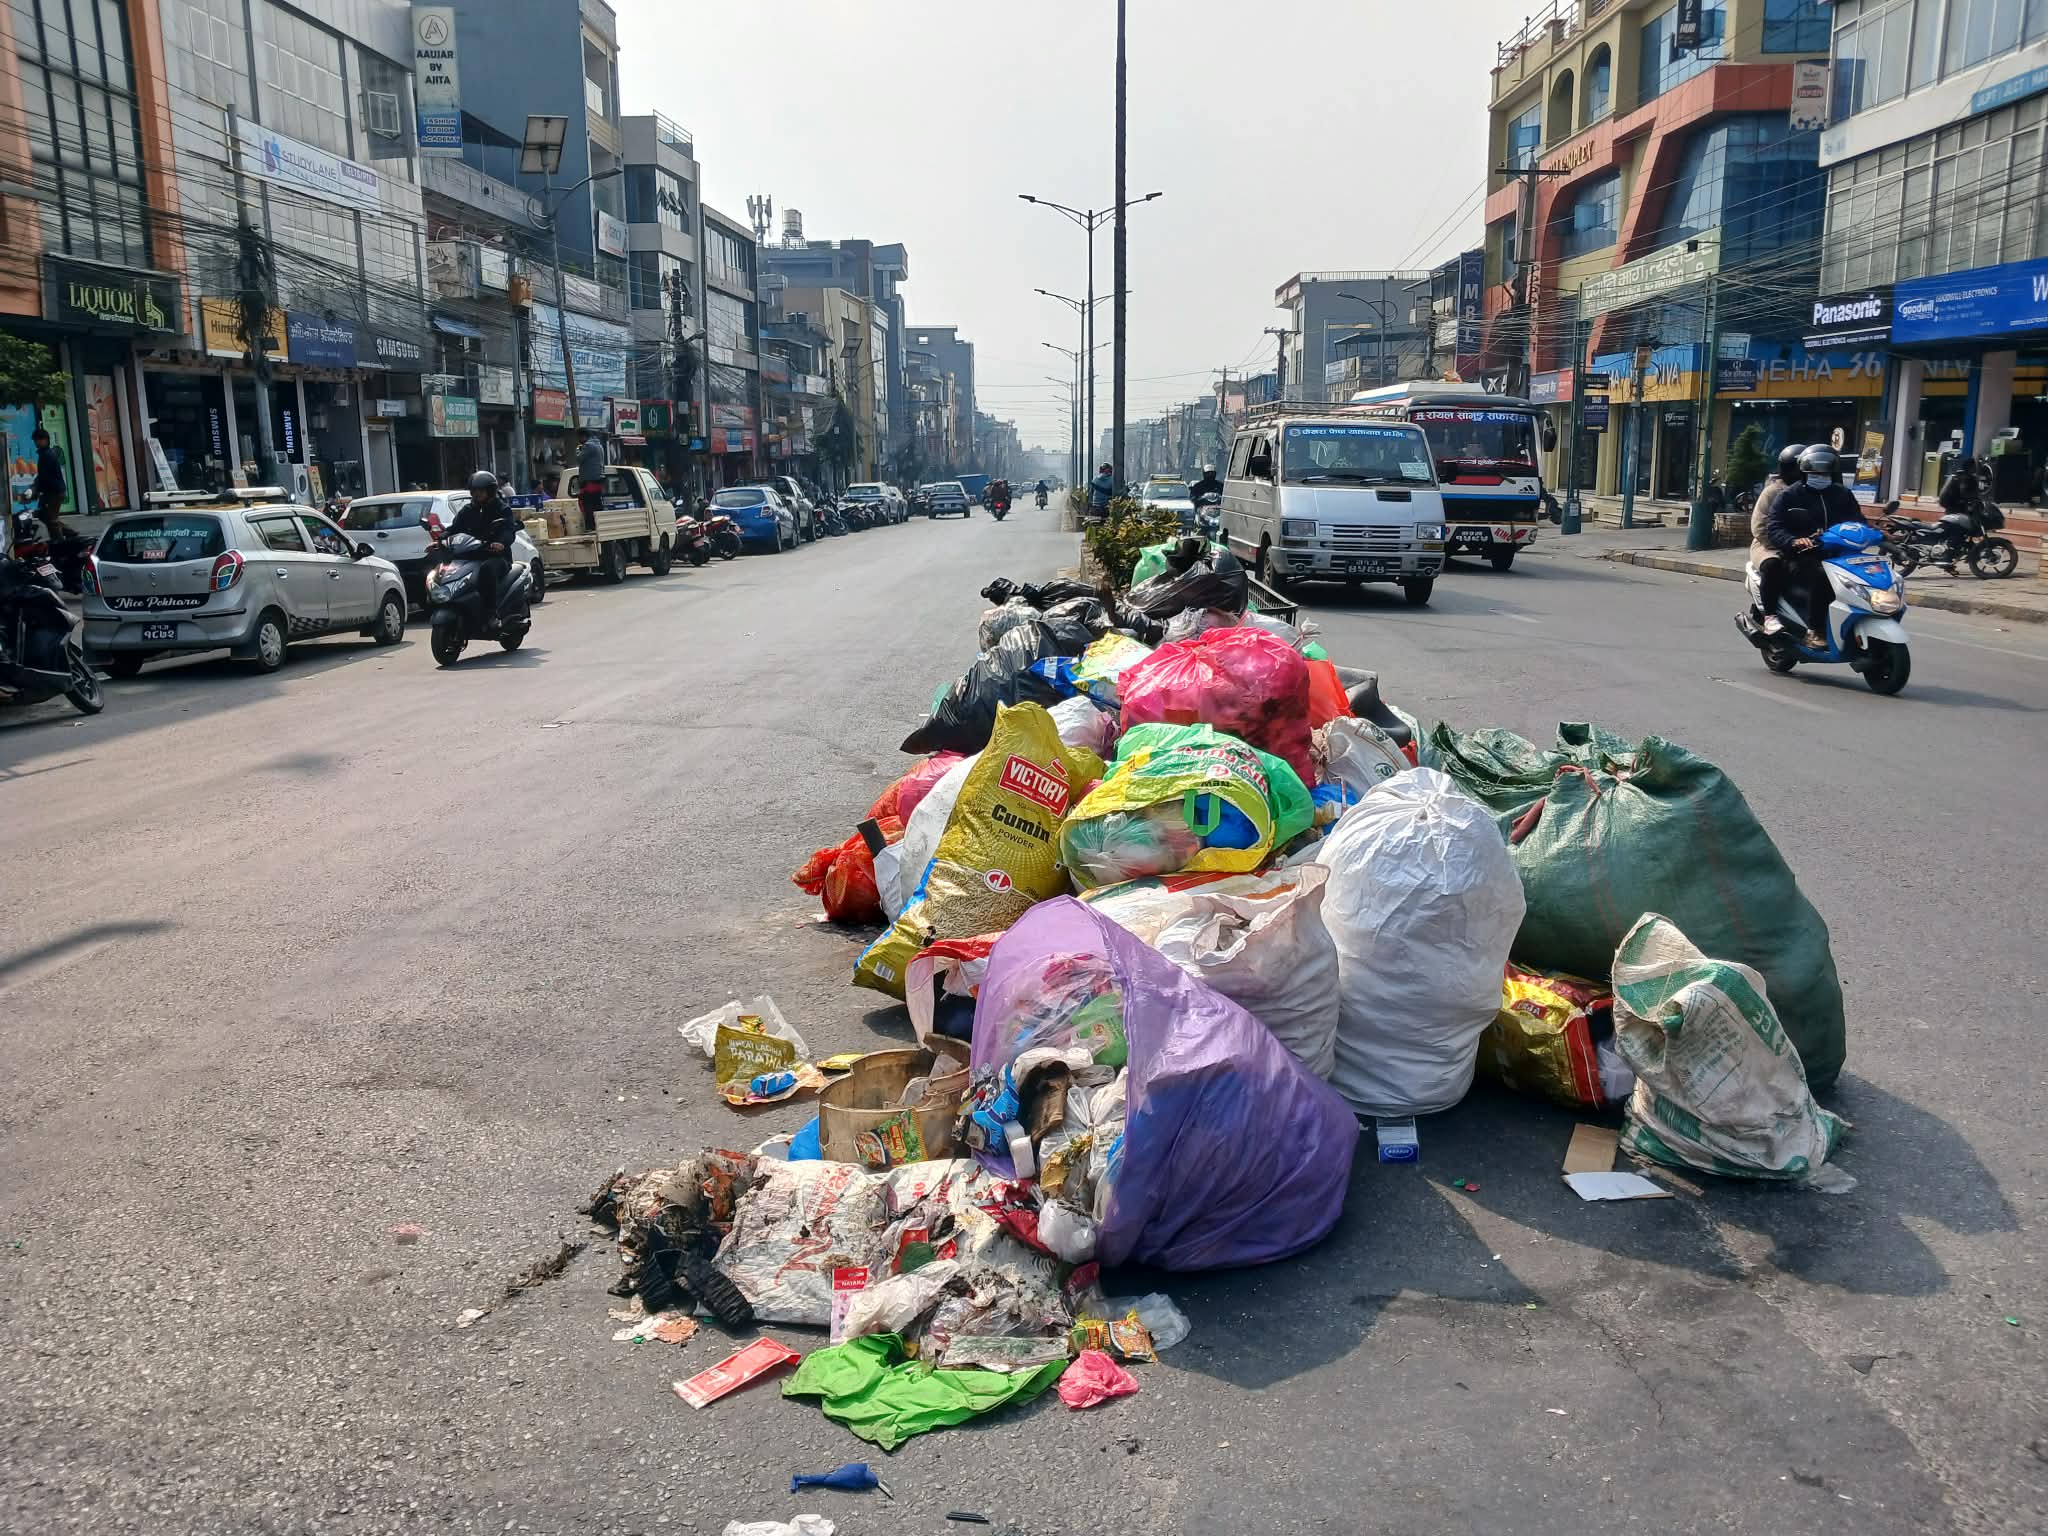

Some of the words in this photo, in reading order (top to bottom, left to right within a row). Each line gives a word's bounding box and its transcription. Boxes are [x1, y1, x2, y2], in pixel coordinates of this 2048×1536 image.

[429, 63, 442, 72] BY
[69, 281, 135, 315] LIQUOR
[1813, 293, 1882, 326] Panasonic
[1902, 300, 1935, 318] goodwill
[376, 337, 420, 359] SAMSUNG
[210, 407, 222, 456] SAMSUNG
[283, 410, 295, 454] SAMSUNG
[146, 551, 164, 559] TAXI
[113, 596, 145, 609] Nice
[146, 595, 200, 609] Pokhara
[1008, 760, 1068, 803] VICTORY
[991, 803, 1051, 843] Cumin
[998, 828, 1034, 850] POWDER
